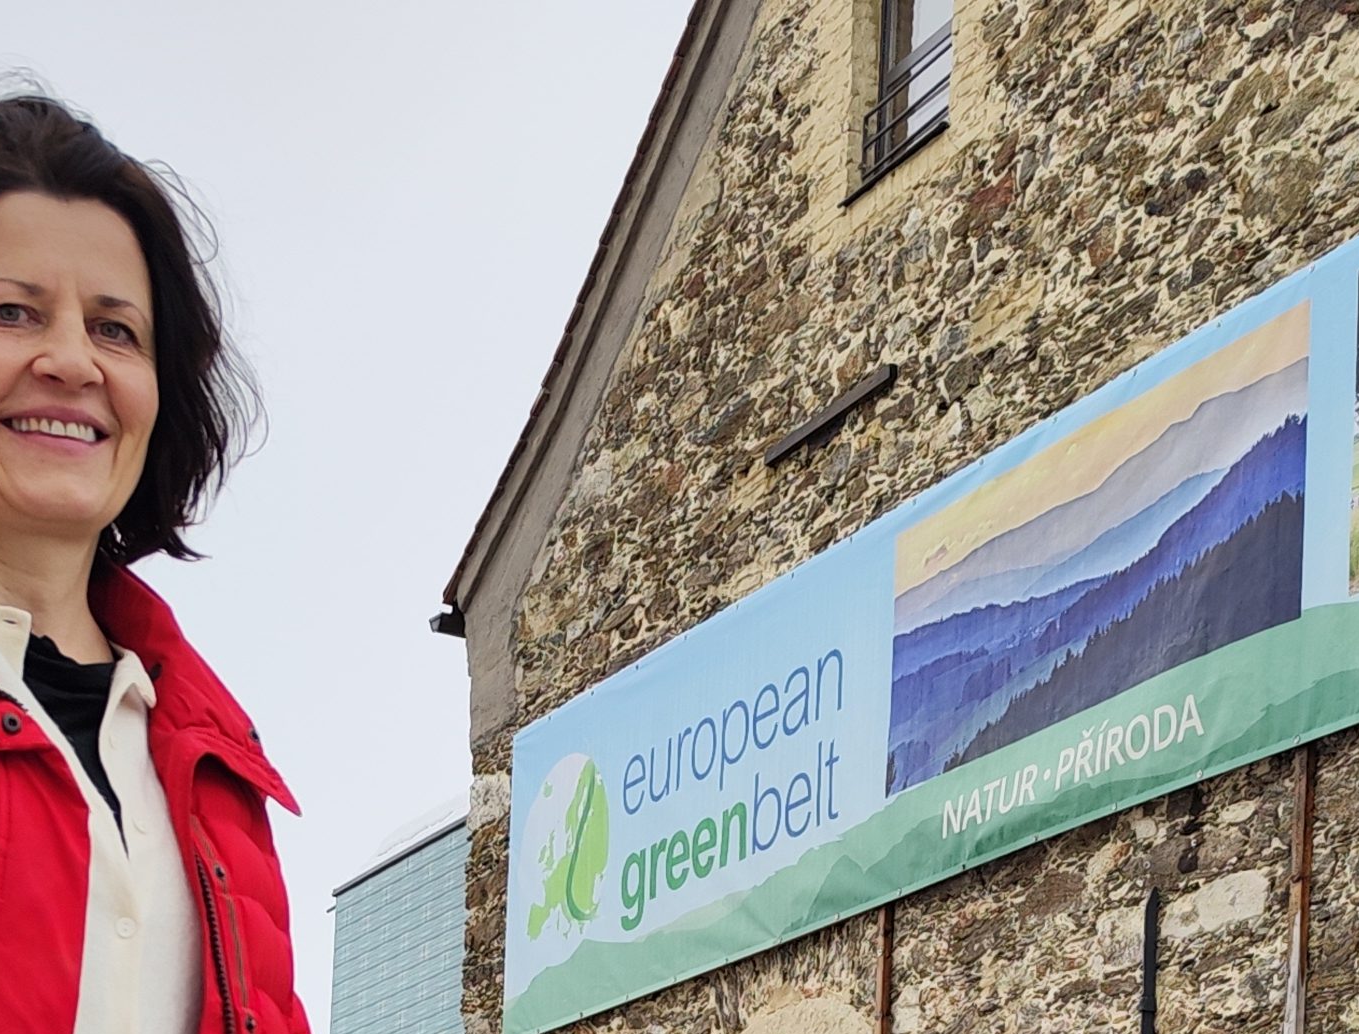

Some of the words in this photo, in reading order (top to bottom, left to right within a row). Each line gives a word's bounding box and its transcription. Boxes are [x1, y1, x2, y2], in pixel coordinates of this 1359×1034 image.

[622, 647, 843, 815] european
[942, 763, 1039, 840] NATUR
[1054, 693, 1205, 793] PŘÍRODA
[619, 741, 840, 932] greenbelt
